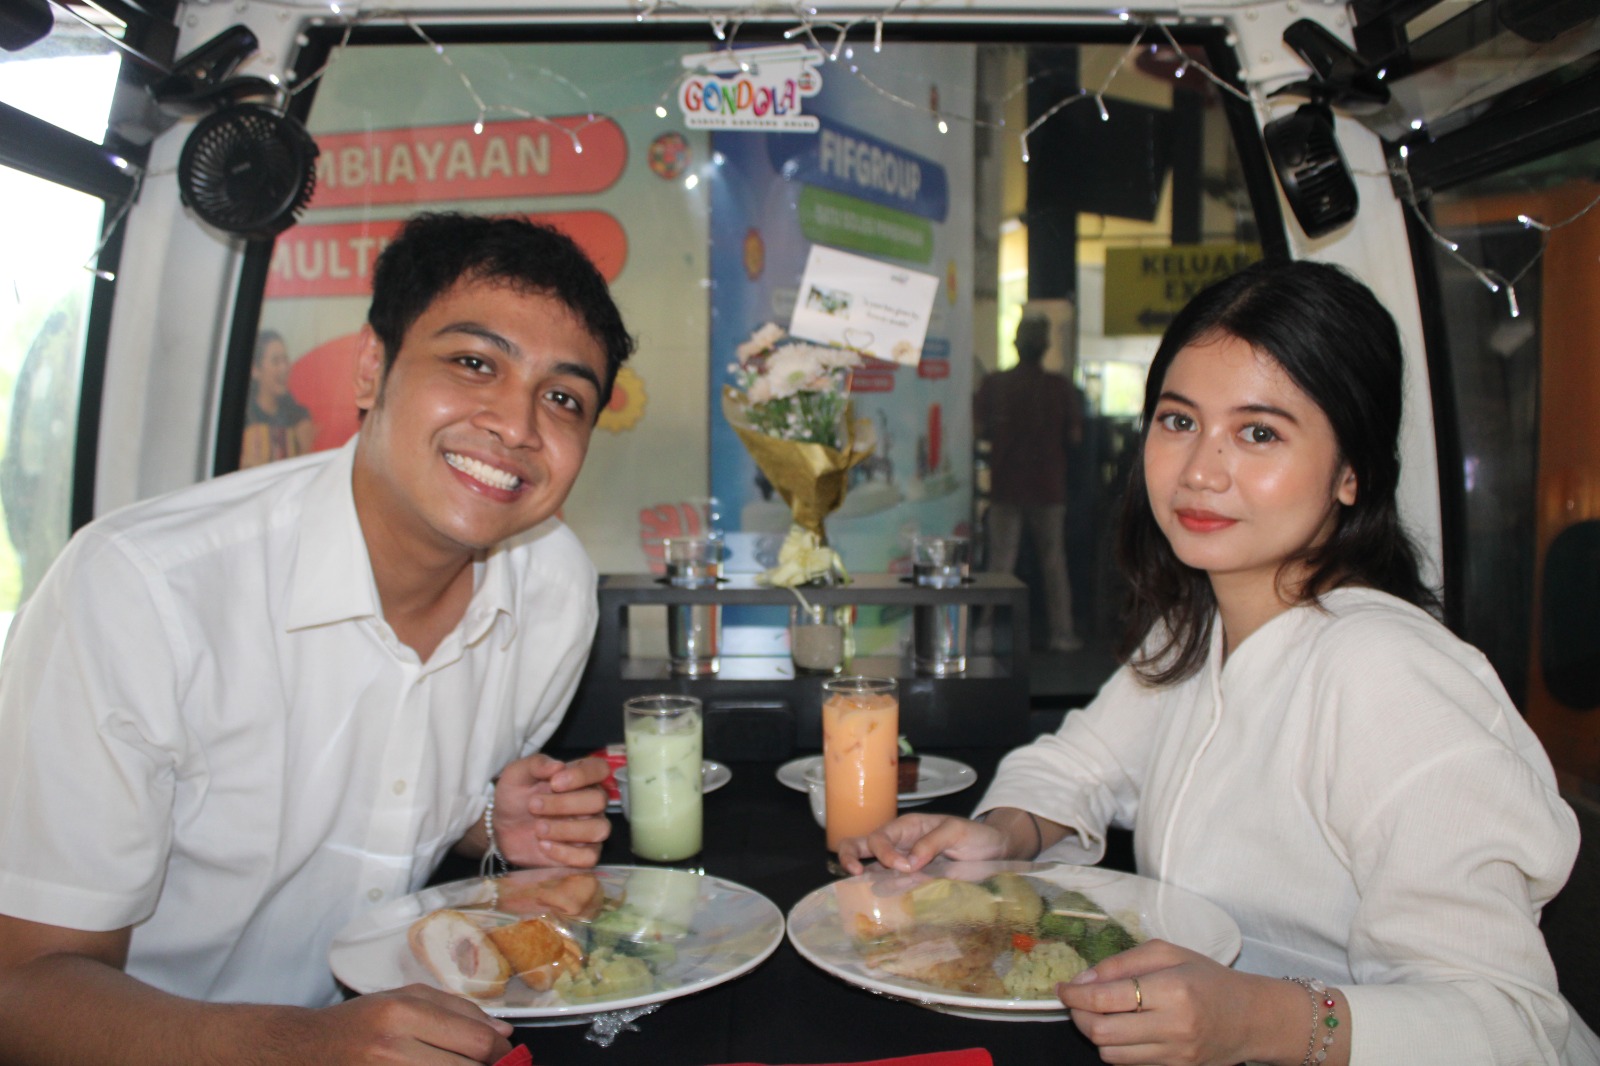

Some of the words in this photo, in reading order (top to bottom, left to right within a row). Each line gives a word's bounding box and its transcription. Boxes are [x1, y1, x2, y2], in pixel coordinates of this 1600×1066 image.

[685, 79, 797, 116] GONDOLA
[316, 133, 551, 188] MBIAYAAN
[819, 128, 922, 201] FIFGROUP
